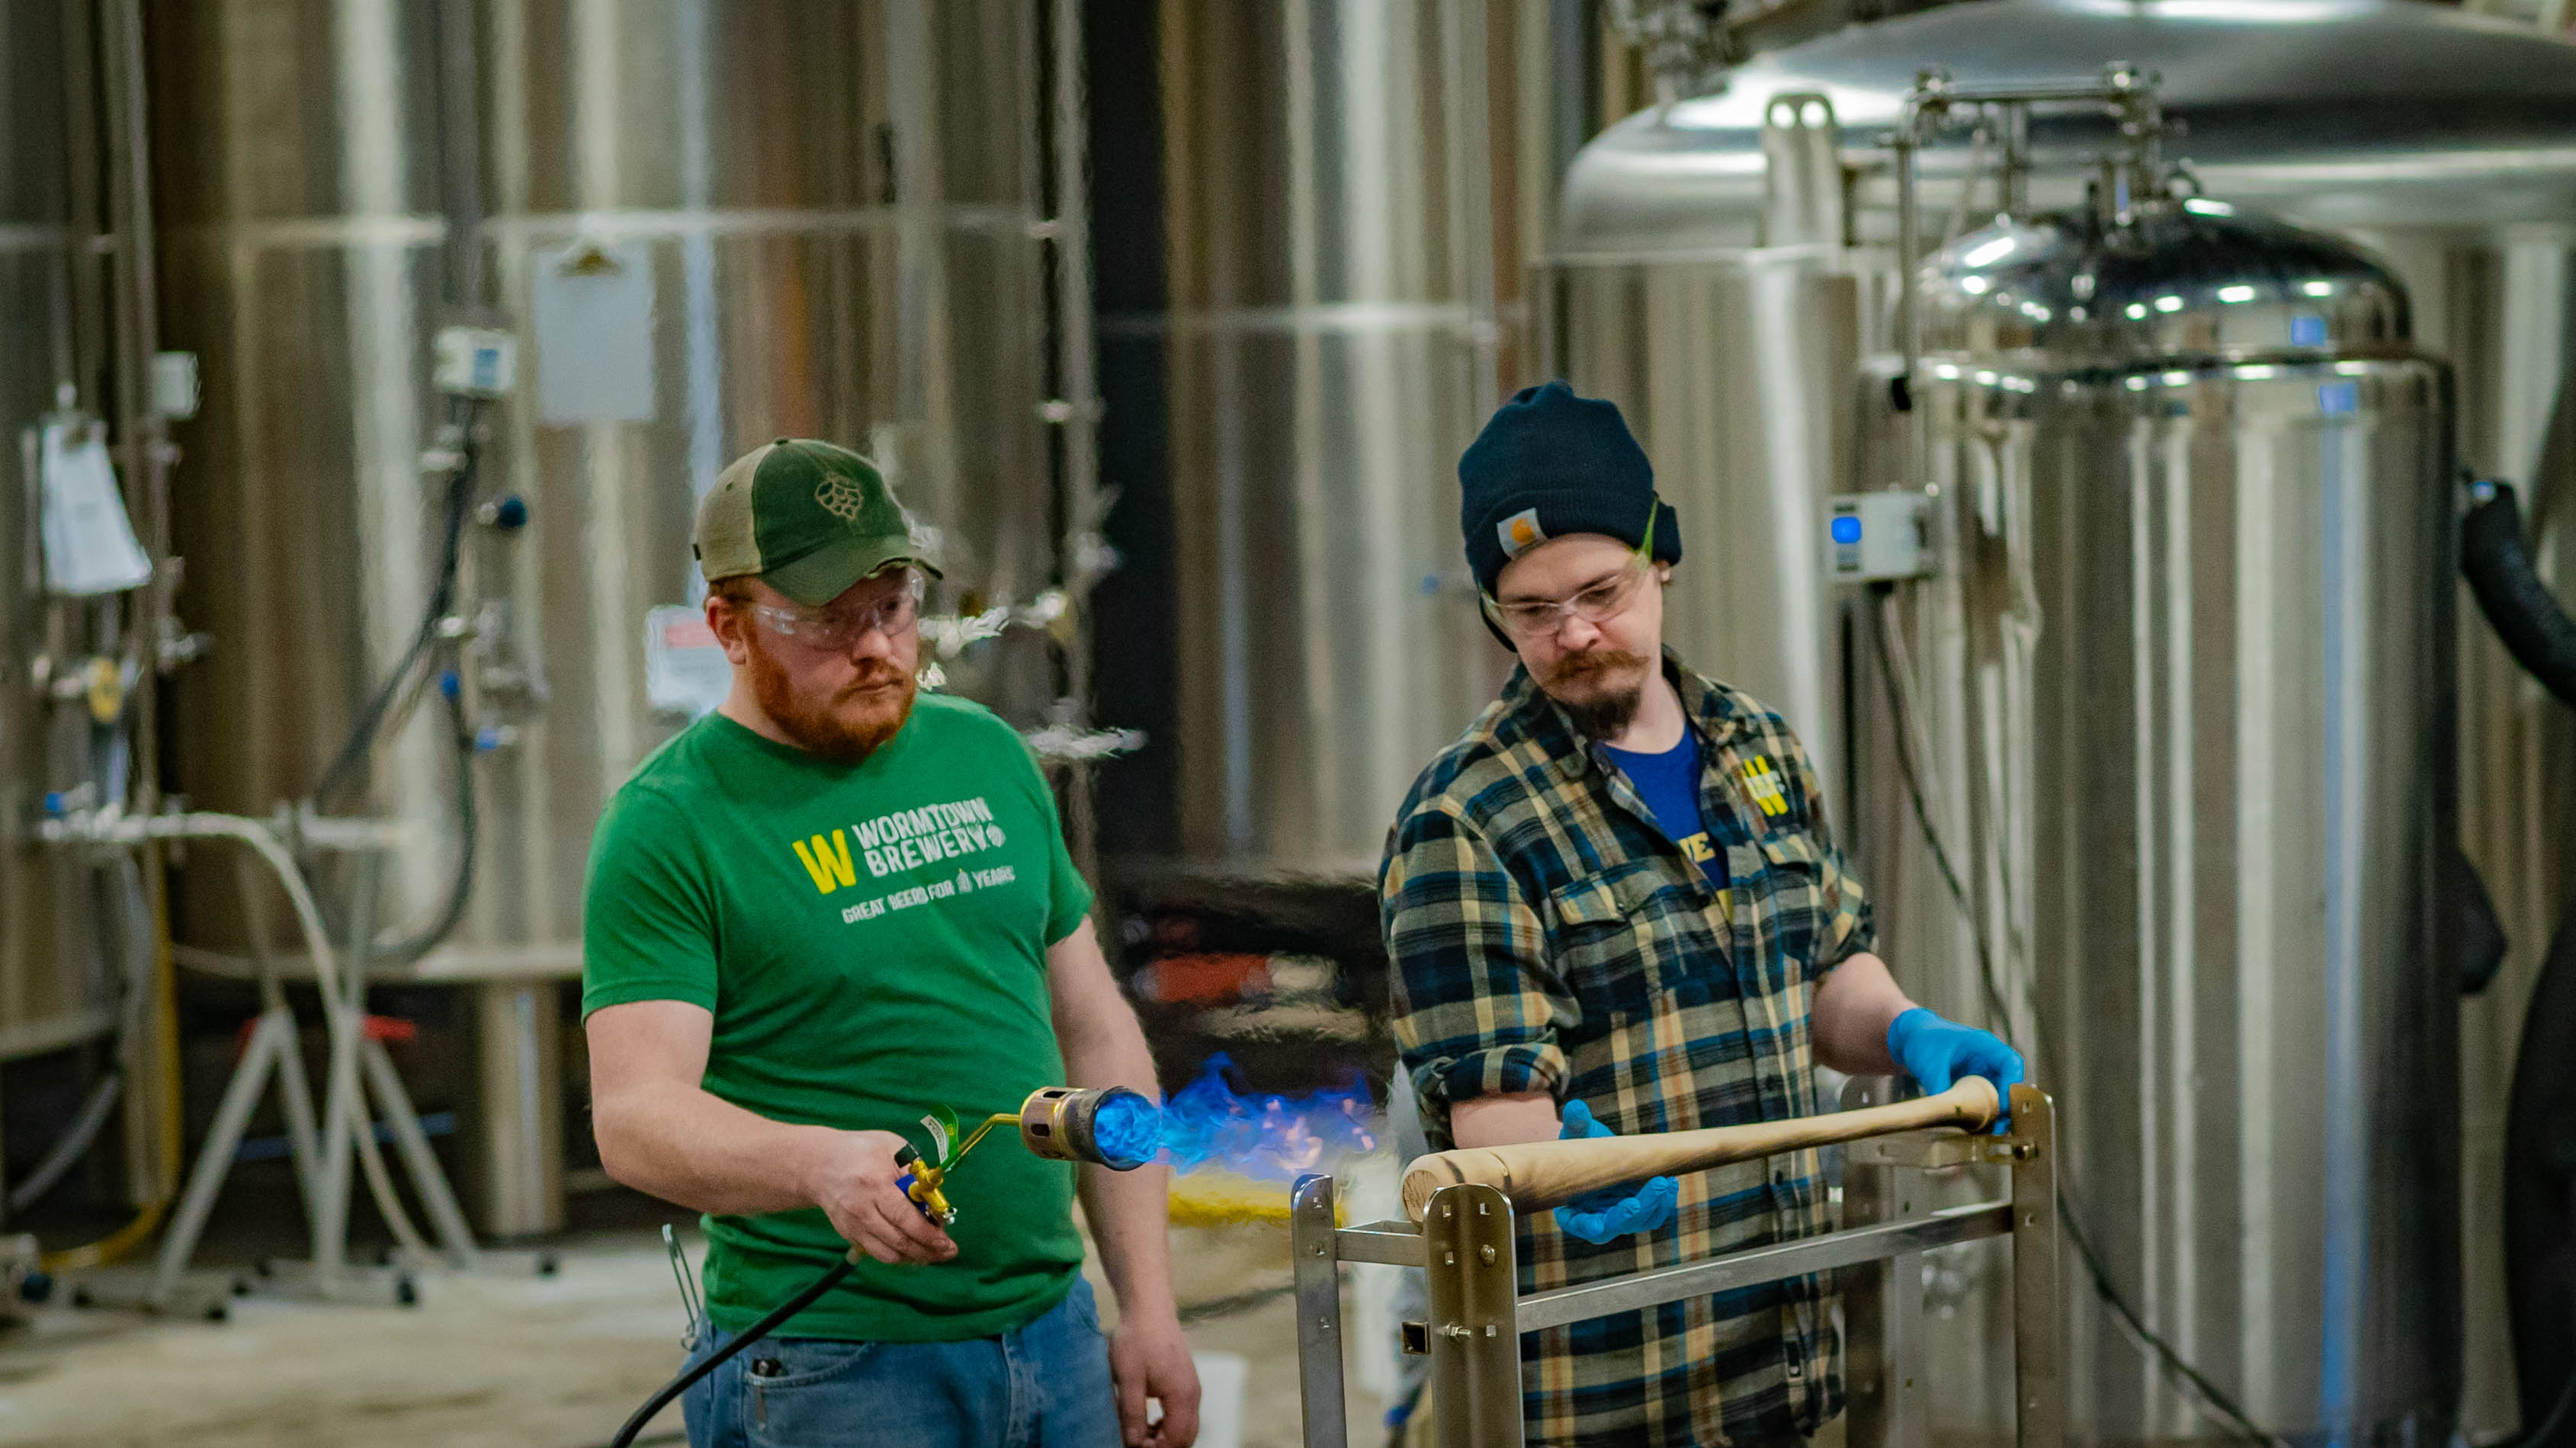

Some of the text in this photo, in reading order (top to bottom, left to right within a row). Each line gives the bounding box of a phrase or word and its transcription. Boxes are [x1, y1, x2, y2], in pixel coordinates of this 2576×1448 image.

[852, 796, 994, 850] WORMTOWN
[864, 824, 989, 877] BREWERY
[792, 828, 857, 895] W
[841, 898, 886, 924] GREAT
[927, 879, 955, 901] FOR
[971, 865, 1015, 889] YEARS
